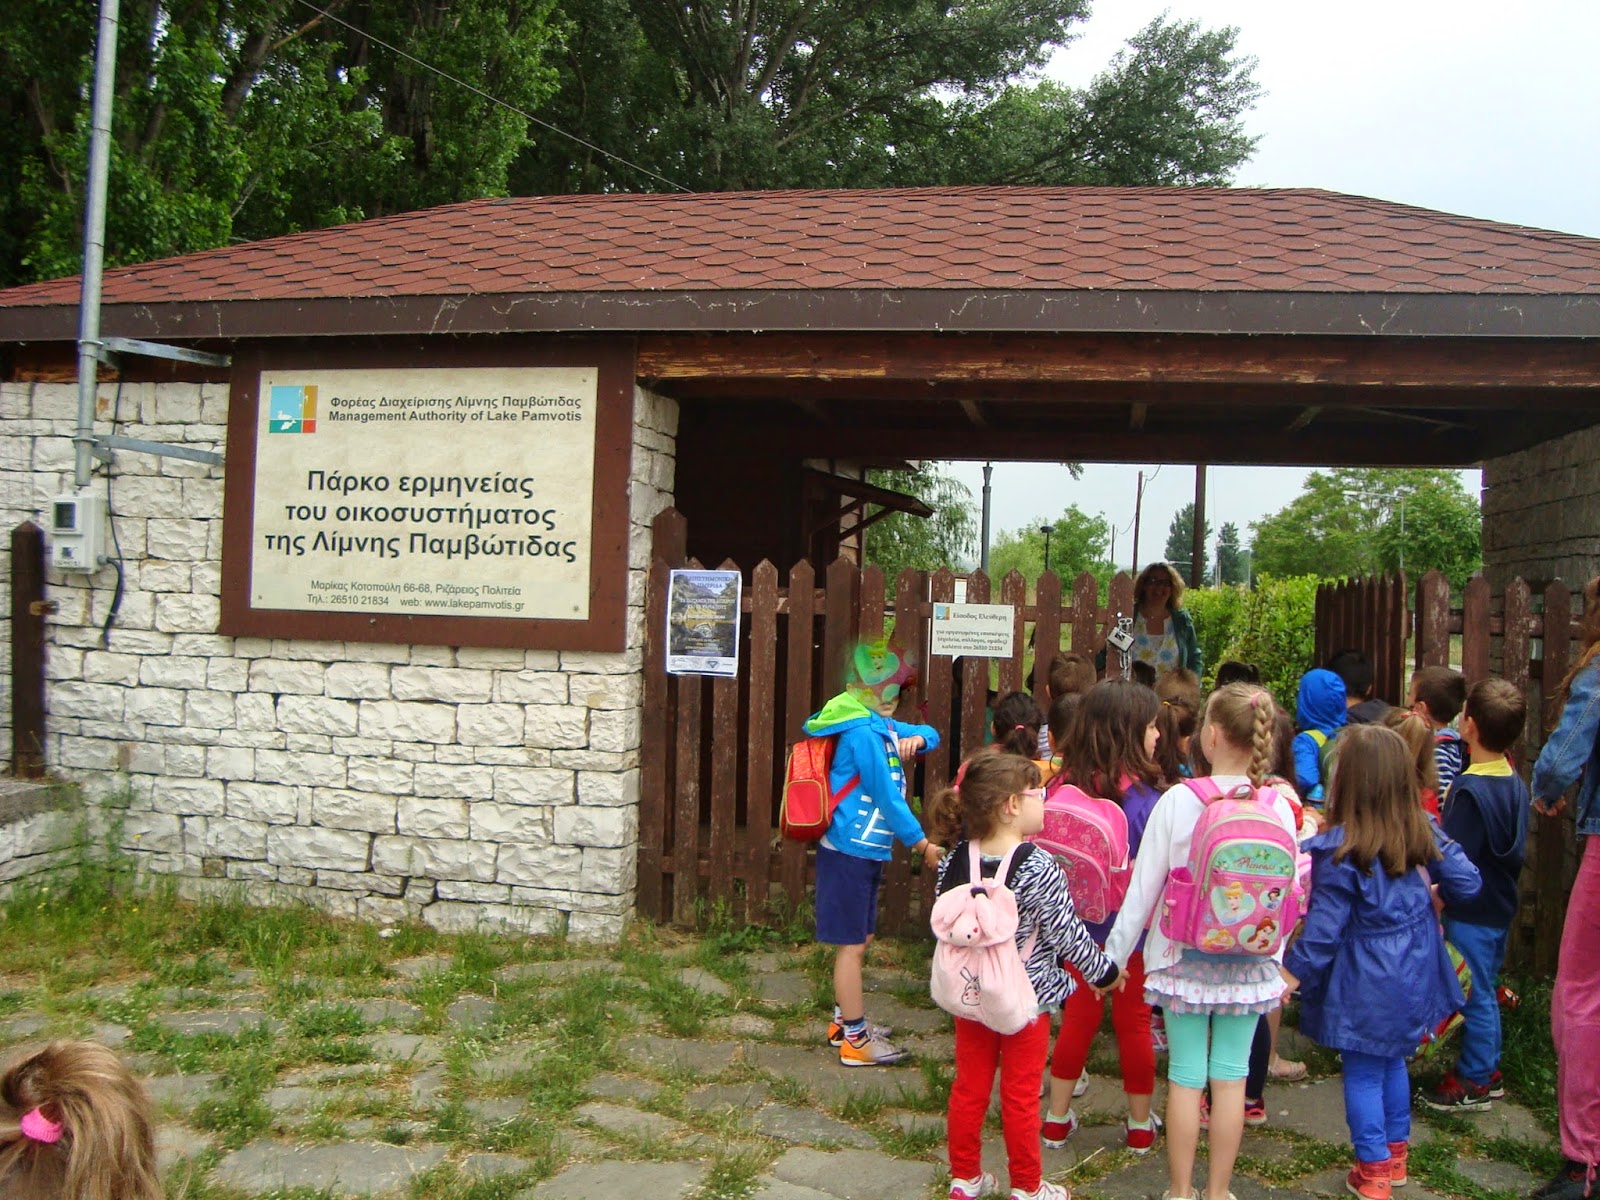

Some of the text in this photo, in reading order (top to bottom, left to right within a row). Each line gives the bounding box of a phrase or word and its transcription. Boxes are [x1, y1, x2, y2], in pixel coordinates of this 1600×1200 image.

[330, 396, 582, 409] Φορέας Διαχείρισης Λίμνης Παμβώτιδας
[328, 410, 582, 423] Management Authority of Lake Pamvotis
[307, 470, 535, 498] Πάρκο ερμηνείας
[285, 502, 556, 530] του οικοσυστήματος
[264, 531, 577, 563] της Λίμνης Παμβώτιδας
[311, 580, 522, 597] Μαρίκας Κοτοπούλη 66-68, Ριζάρειος Πολιτεία
[330, 595, 359, 605] 26510
[361, 595, 390, 606] 21834
[400, 597, 422, 607] web:
[424, 598, 525, 612] www.lakepamvotis.gr
